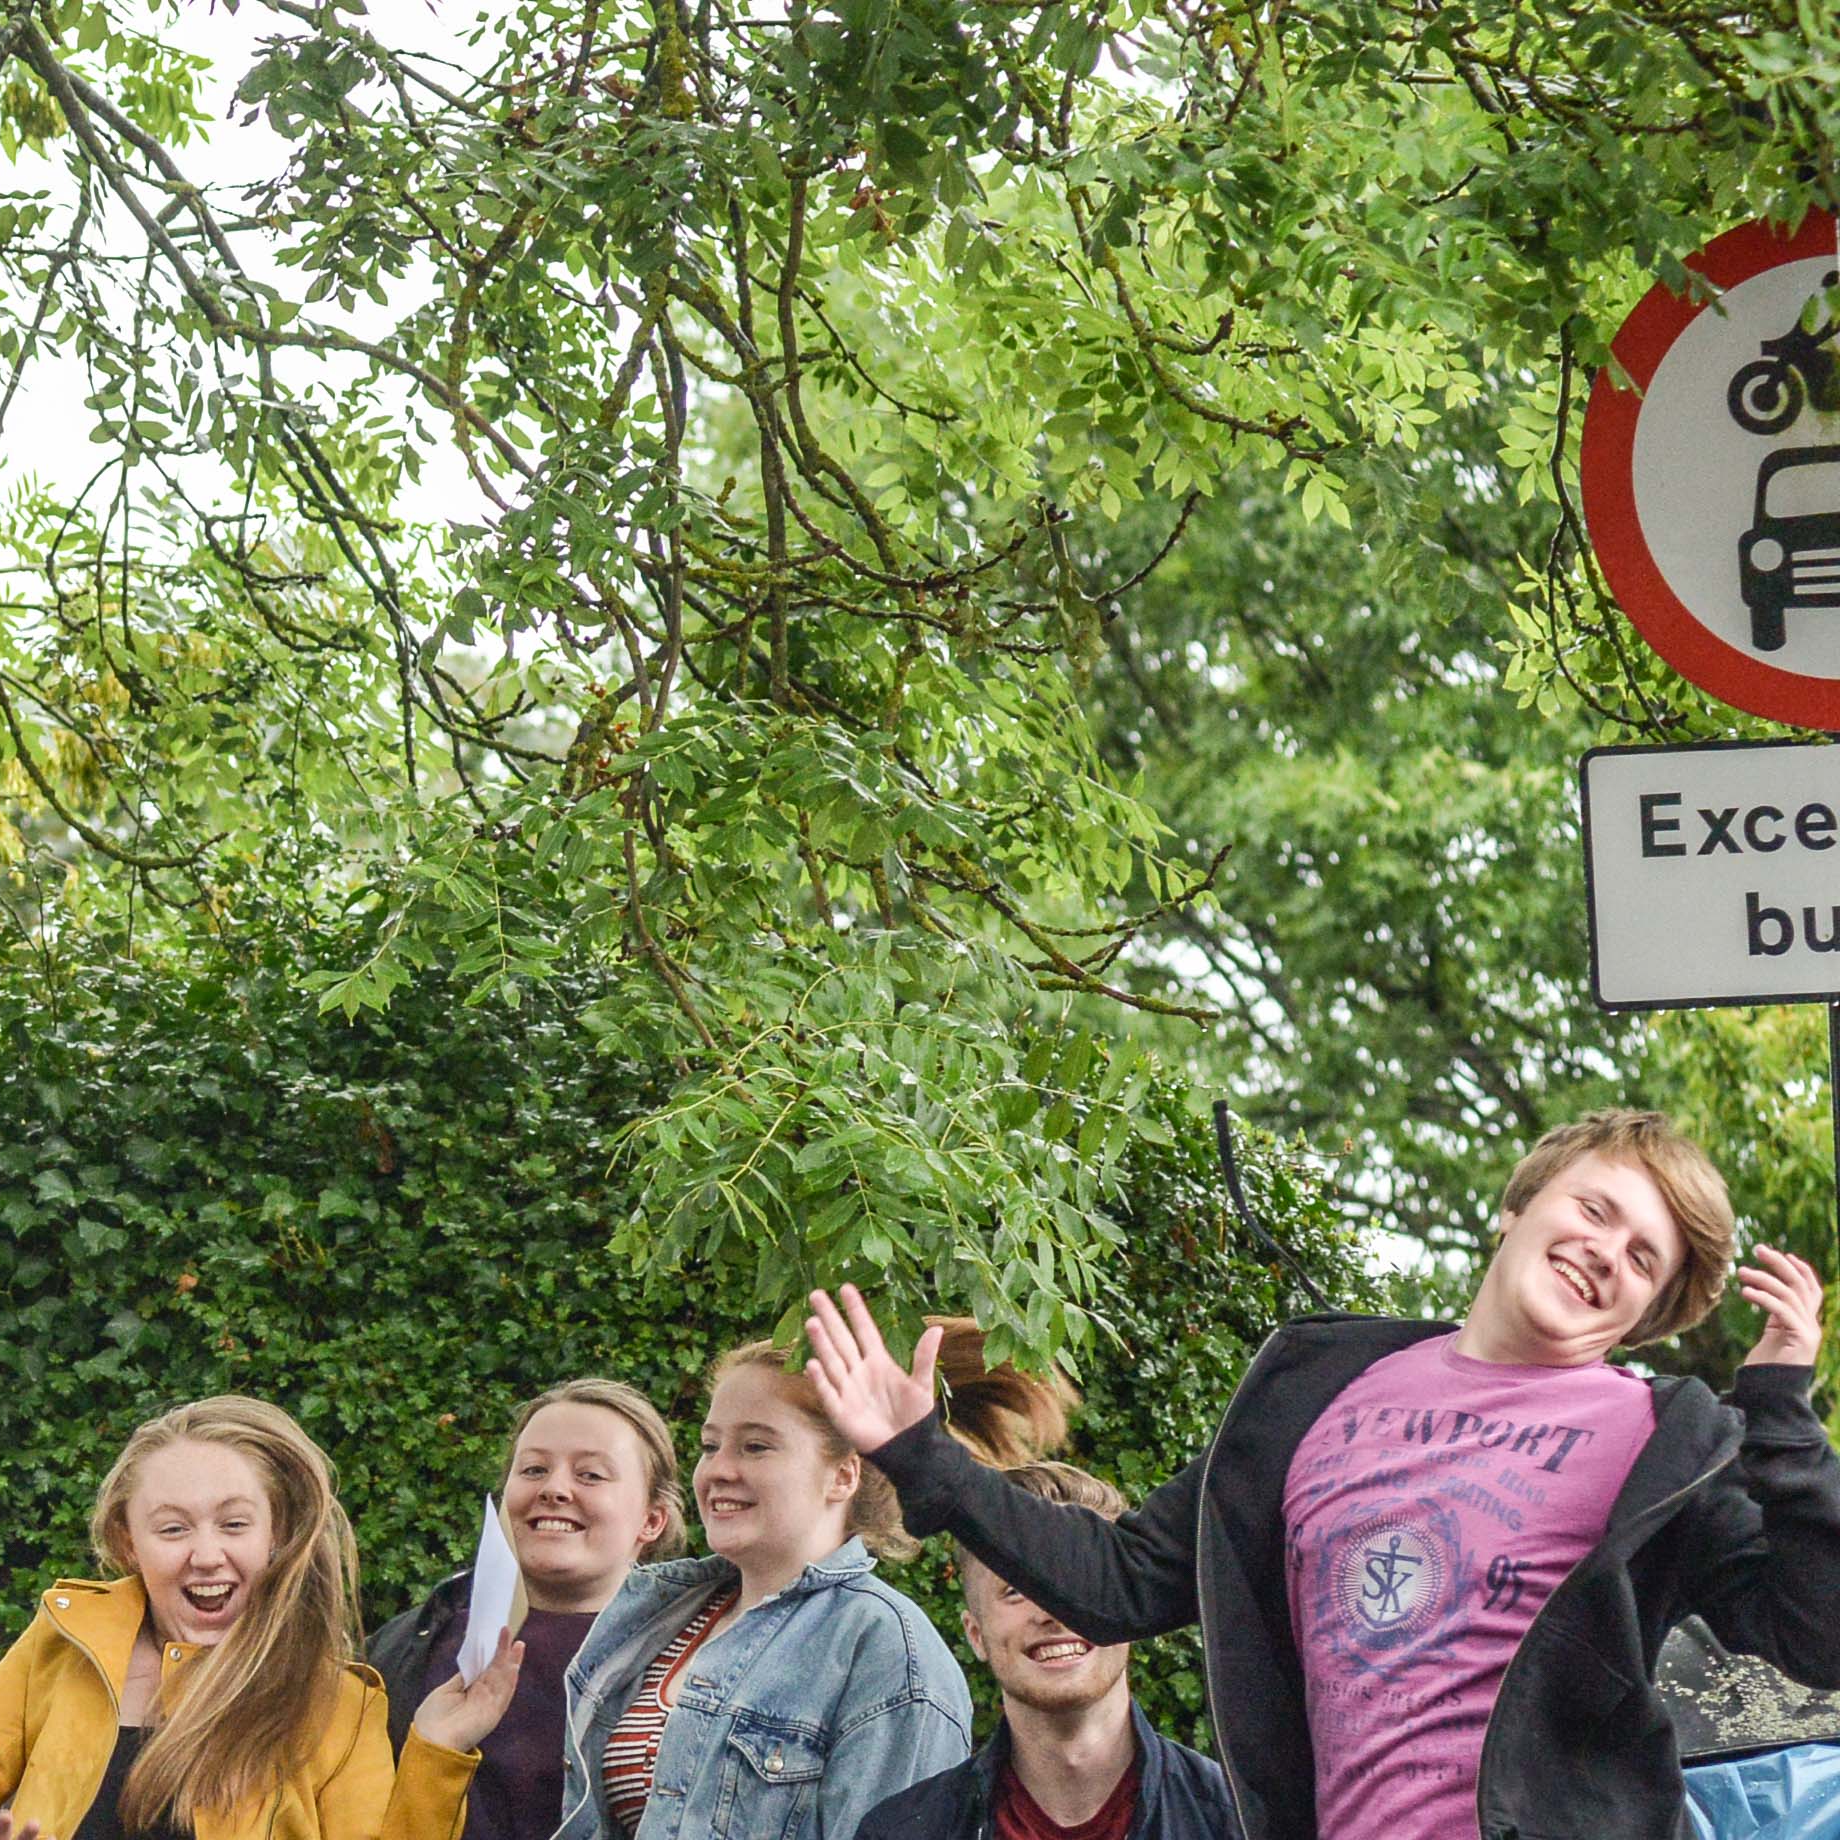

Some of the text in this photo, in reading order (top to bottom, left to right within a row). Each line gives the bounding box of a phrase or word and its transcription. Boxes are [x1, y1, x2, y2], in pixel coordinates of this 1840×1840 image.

[1639, 792, 1838, 858] Exce
[1745, 891, 1840, 956] bu
[1321, 1405, 1595, 1475] NEWPORT
